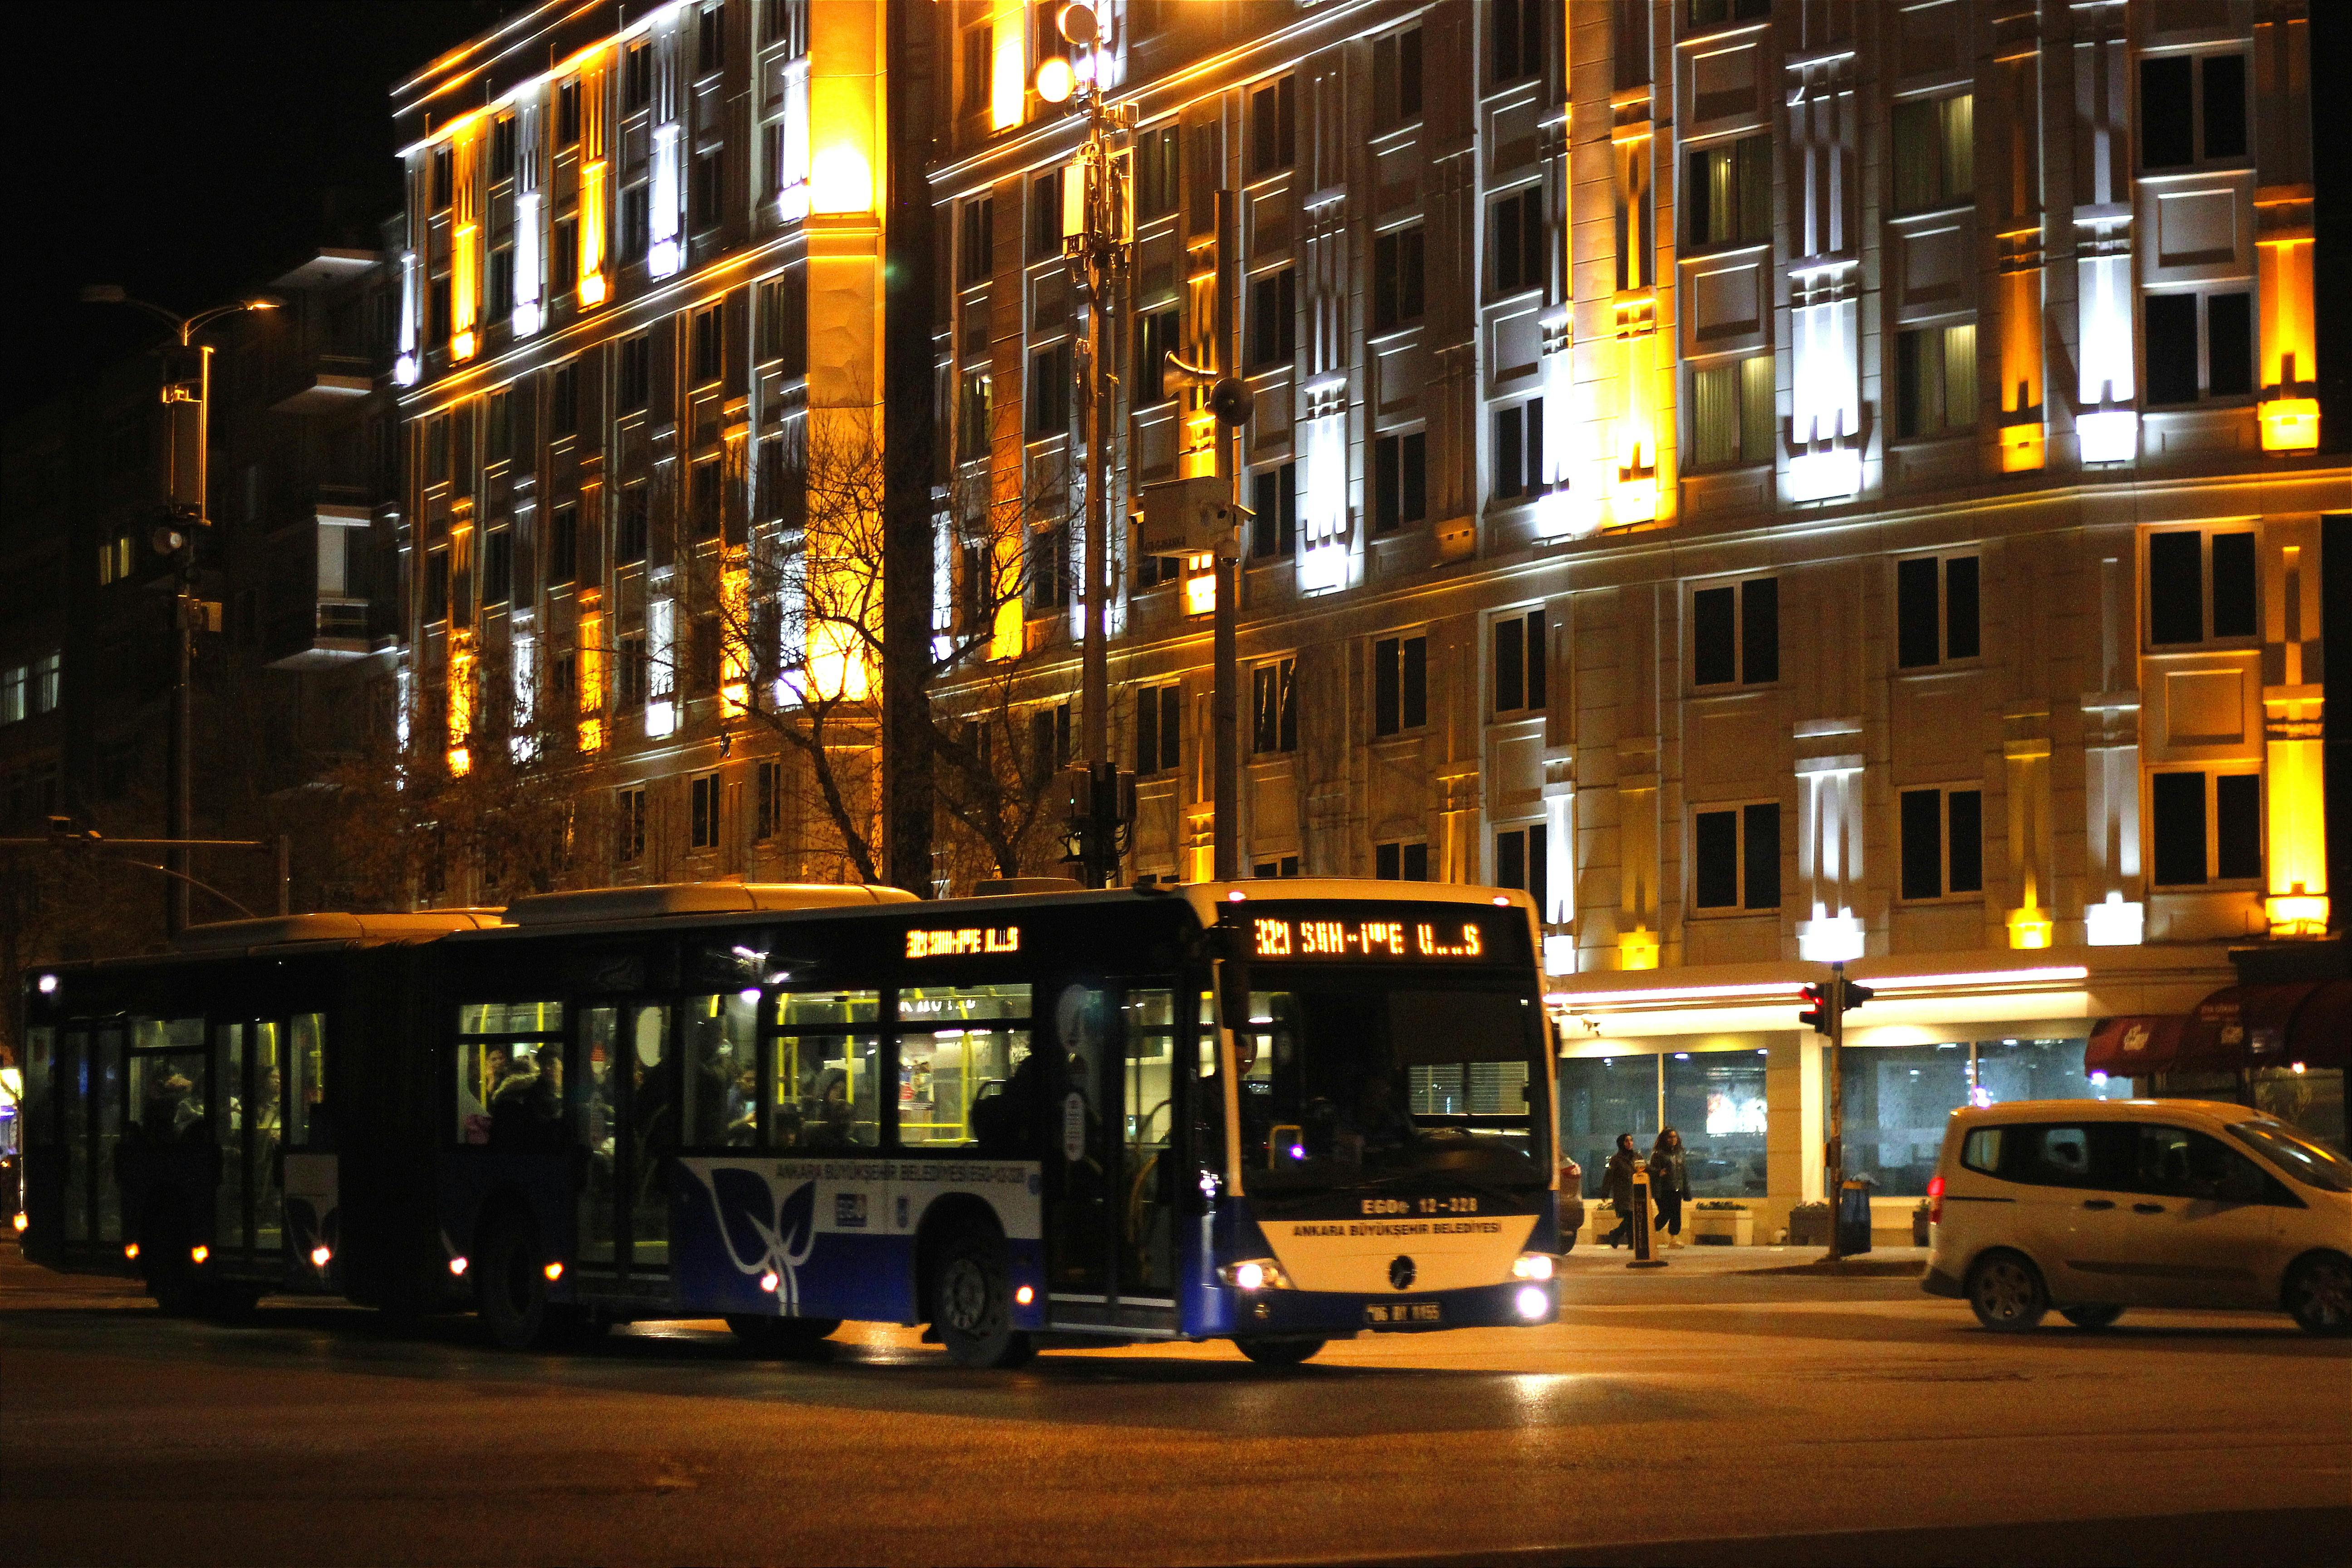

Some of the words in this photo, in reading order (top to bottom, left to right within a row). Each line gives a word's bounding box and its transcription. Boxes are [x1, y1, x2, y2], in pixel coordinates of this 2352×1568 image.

[1294, 1225, 1345, 1237] ANKARA
[1349, 1222, 1429, 1238] BÜYÜKŞEHİR
[1433, 1220, 1501, 1234] BELEDİYESİ
